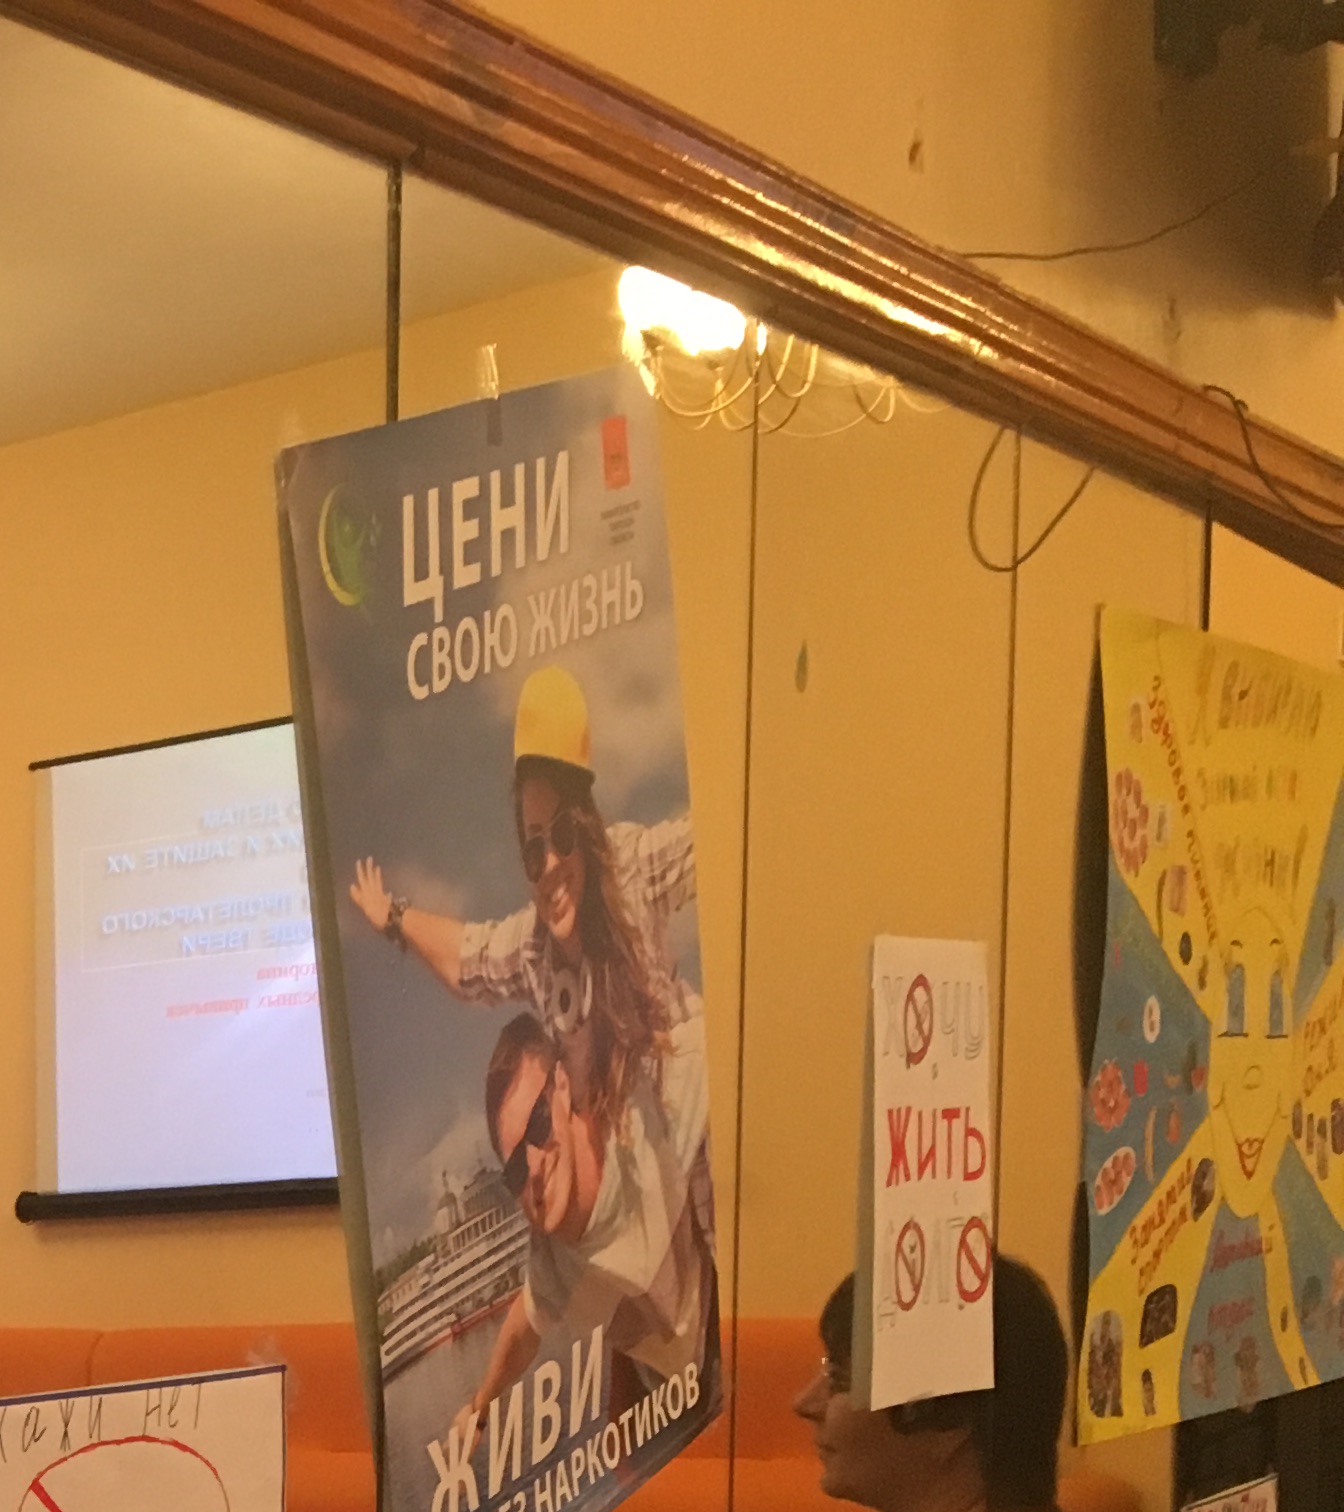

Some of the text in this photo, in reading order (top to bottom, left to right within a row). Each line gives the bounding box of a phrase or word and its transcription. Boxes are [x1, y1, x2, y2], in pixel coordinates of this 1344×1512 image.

[401, 450, 570, 622] ЦЕНИ
[406, 560, 645, 700] СВОЮ ЖИЗНЬ
[885, 1106, 987, 1188] ЖИТЬ
